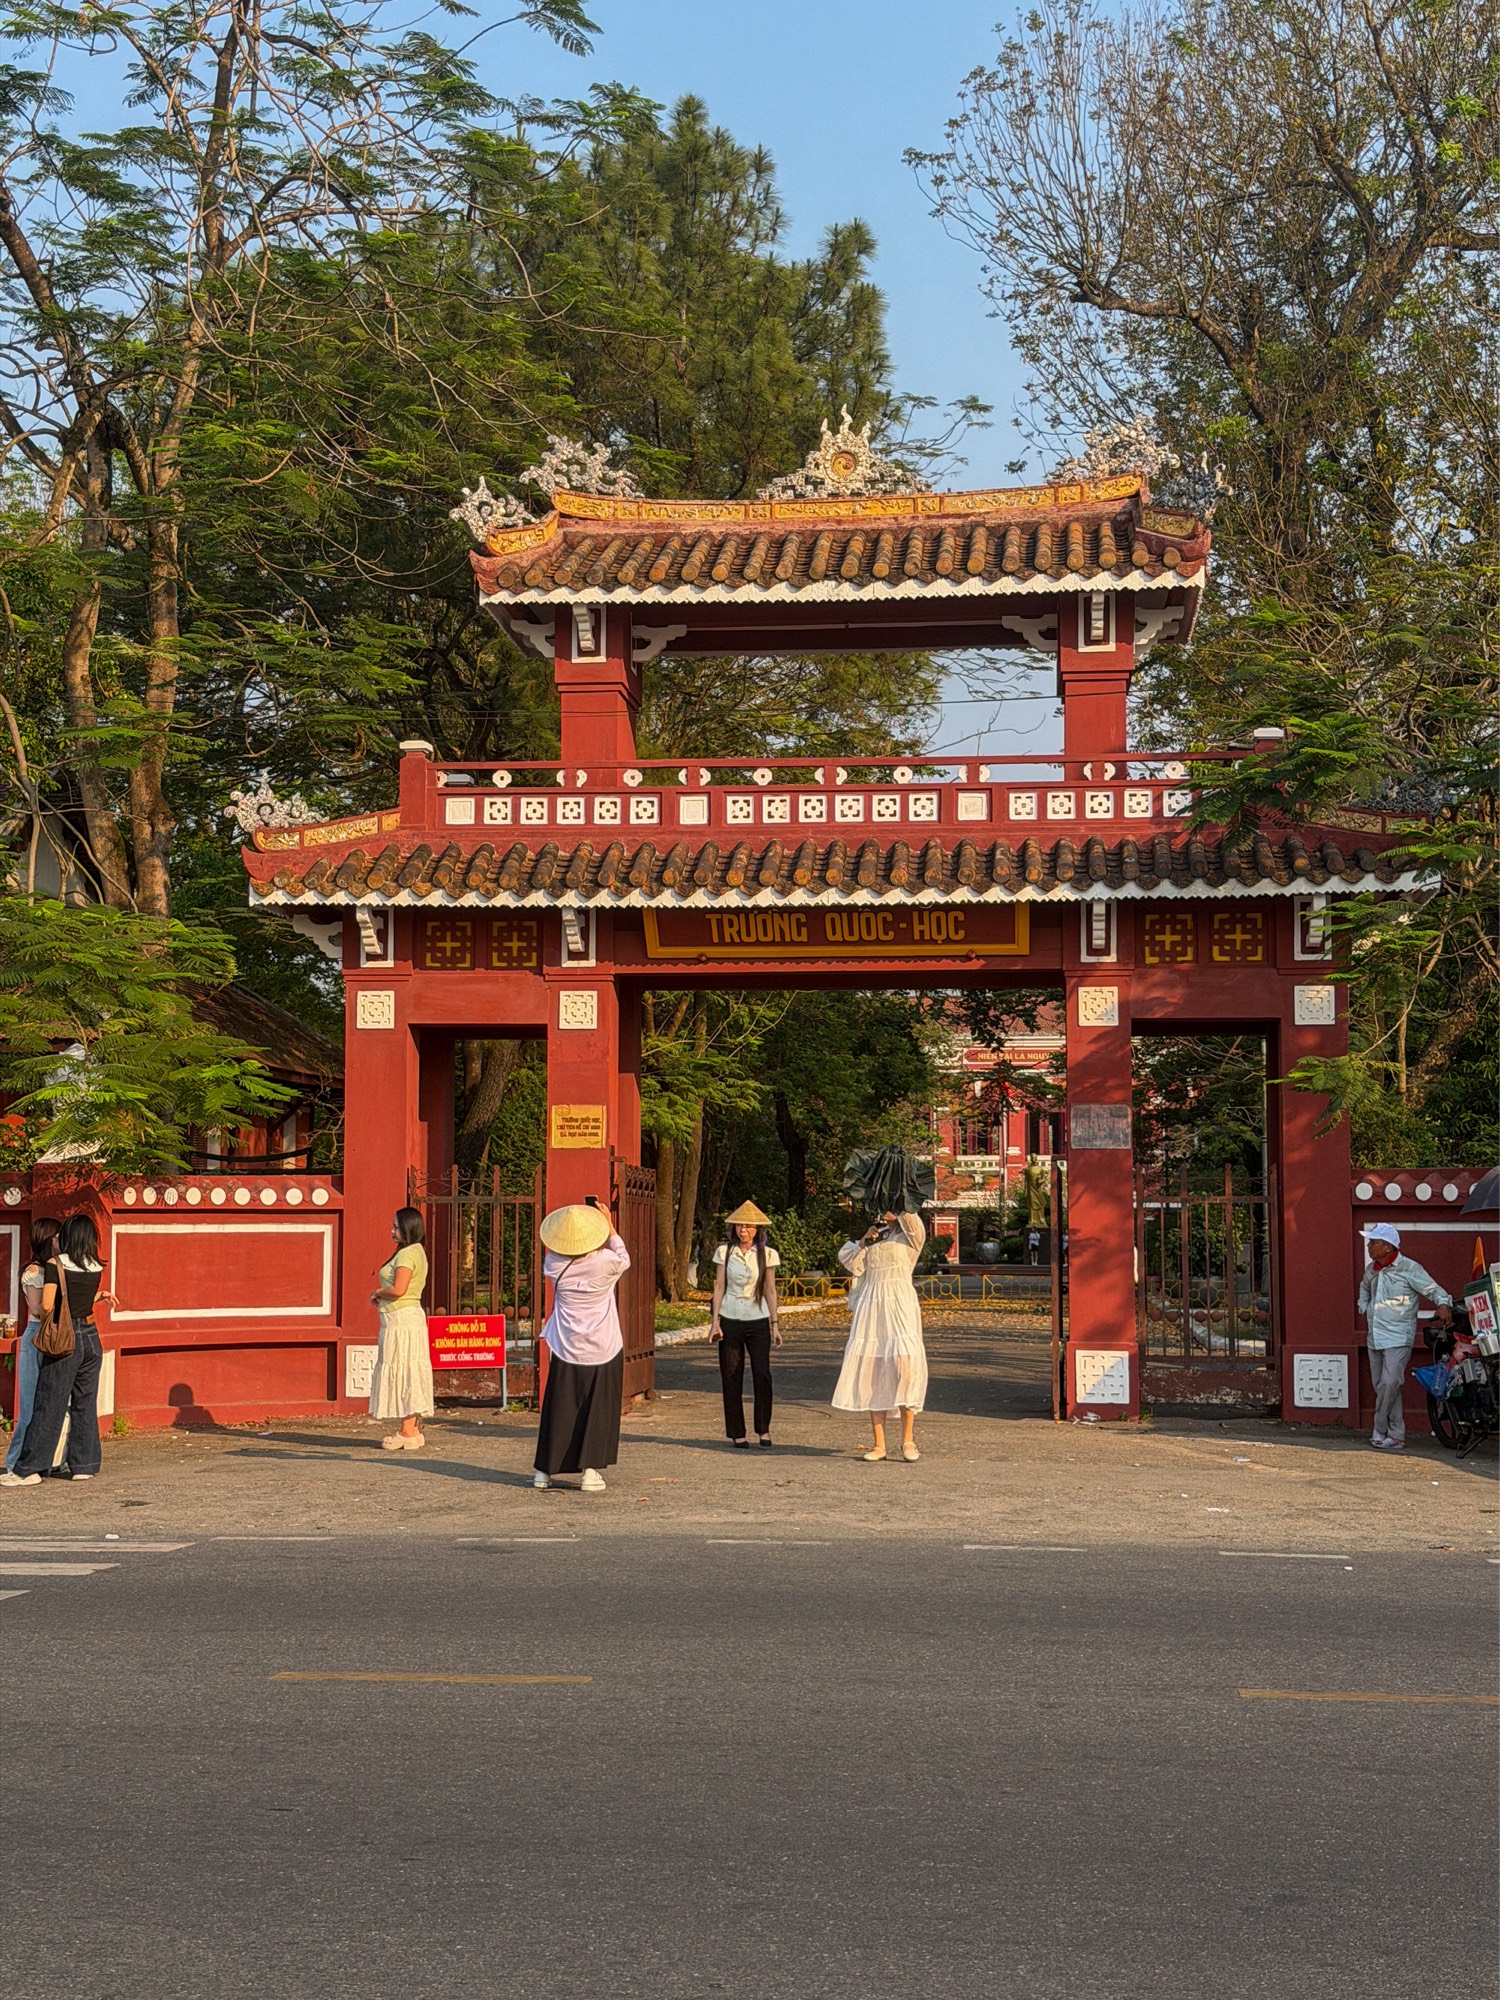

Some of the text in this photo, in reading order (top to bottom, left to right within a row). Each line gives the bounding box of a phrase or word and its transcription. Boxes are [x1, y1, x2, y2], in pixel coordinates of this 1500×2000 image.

[1473, 1294, 1489, 1313] KEM
[479, 1322, 487, 1333] XE
[456, 1336, 468, 1348] BÁN
[468, 1336, 484, 1348] HÀNG
[485, 1337, 502, 1347] RONG
[439, 1351, 495, 1362] TRƯỚC CỔNG TRƯỜNG
